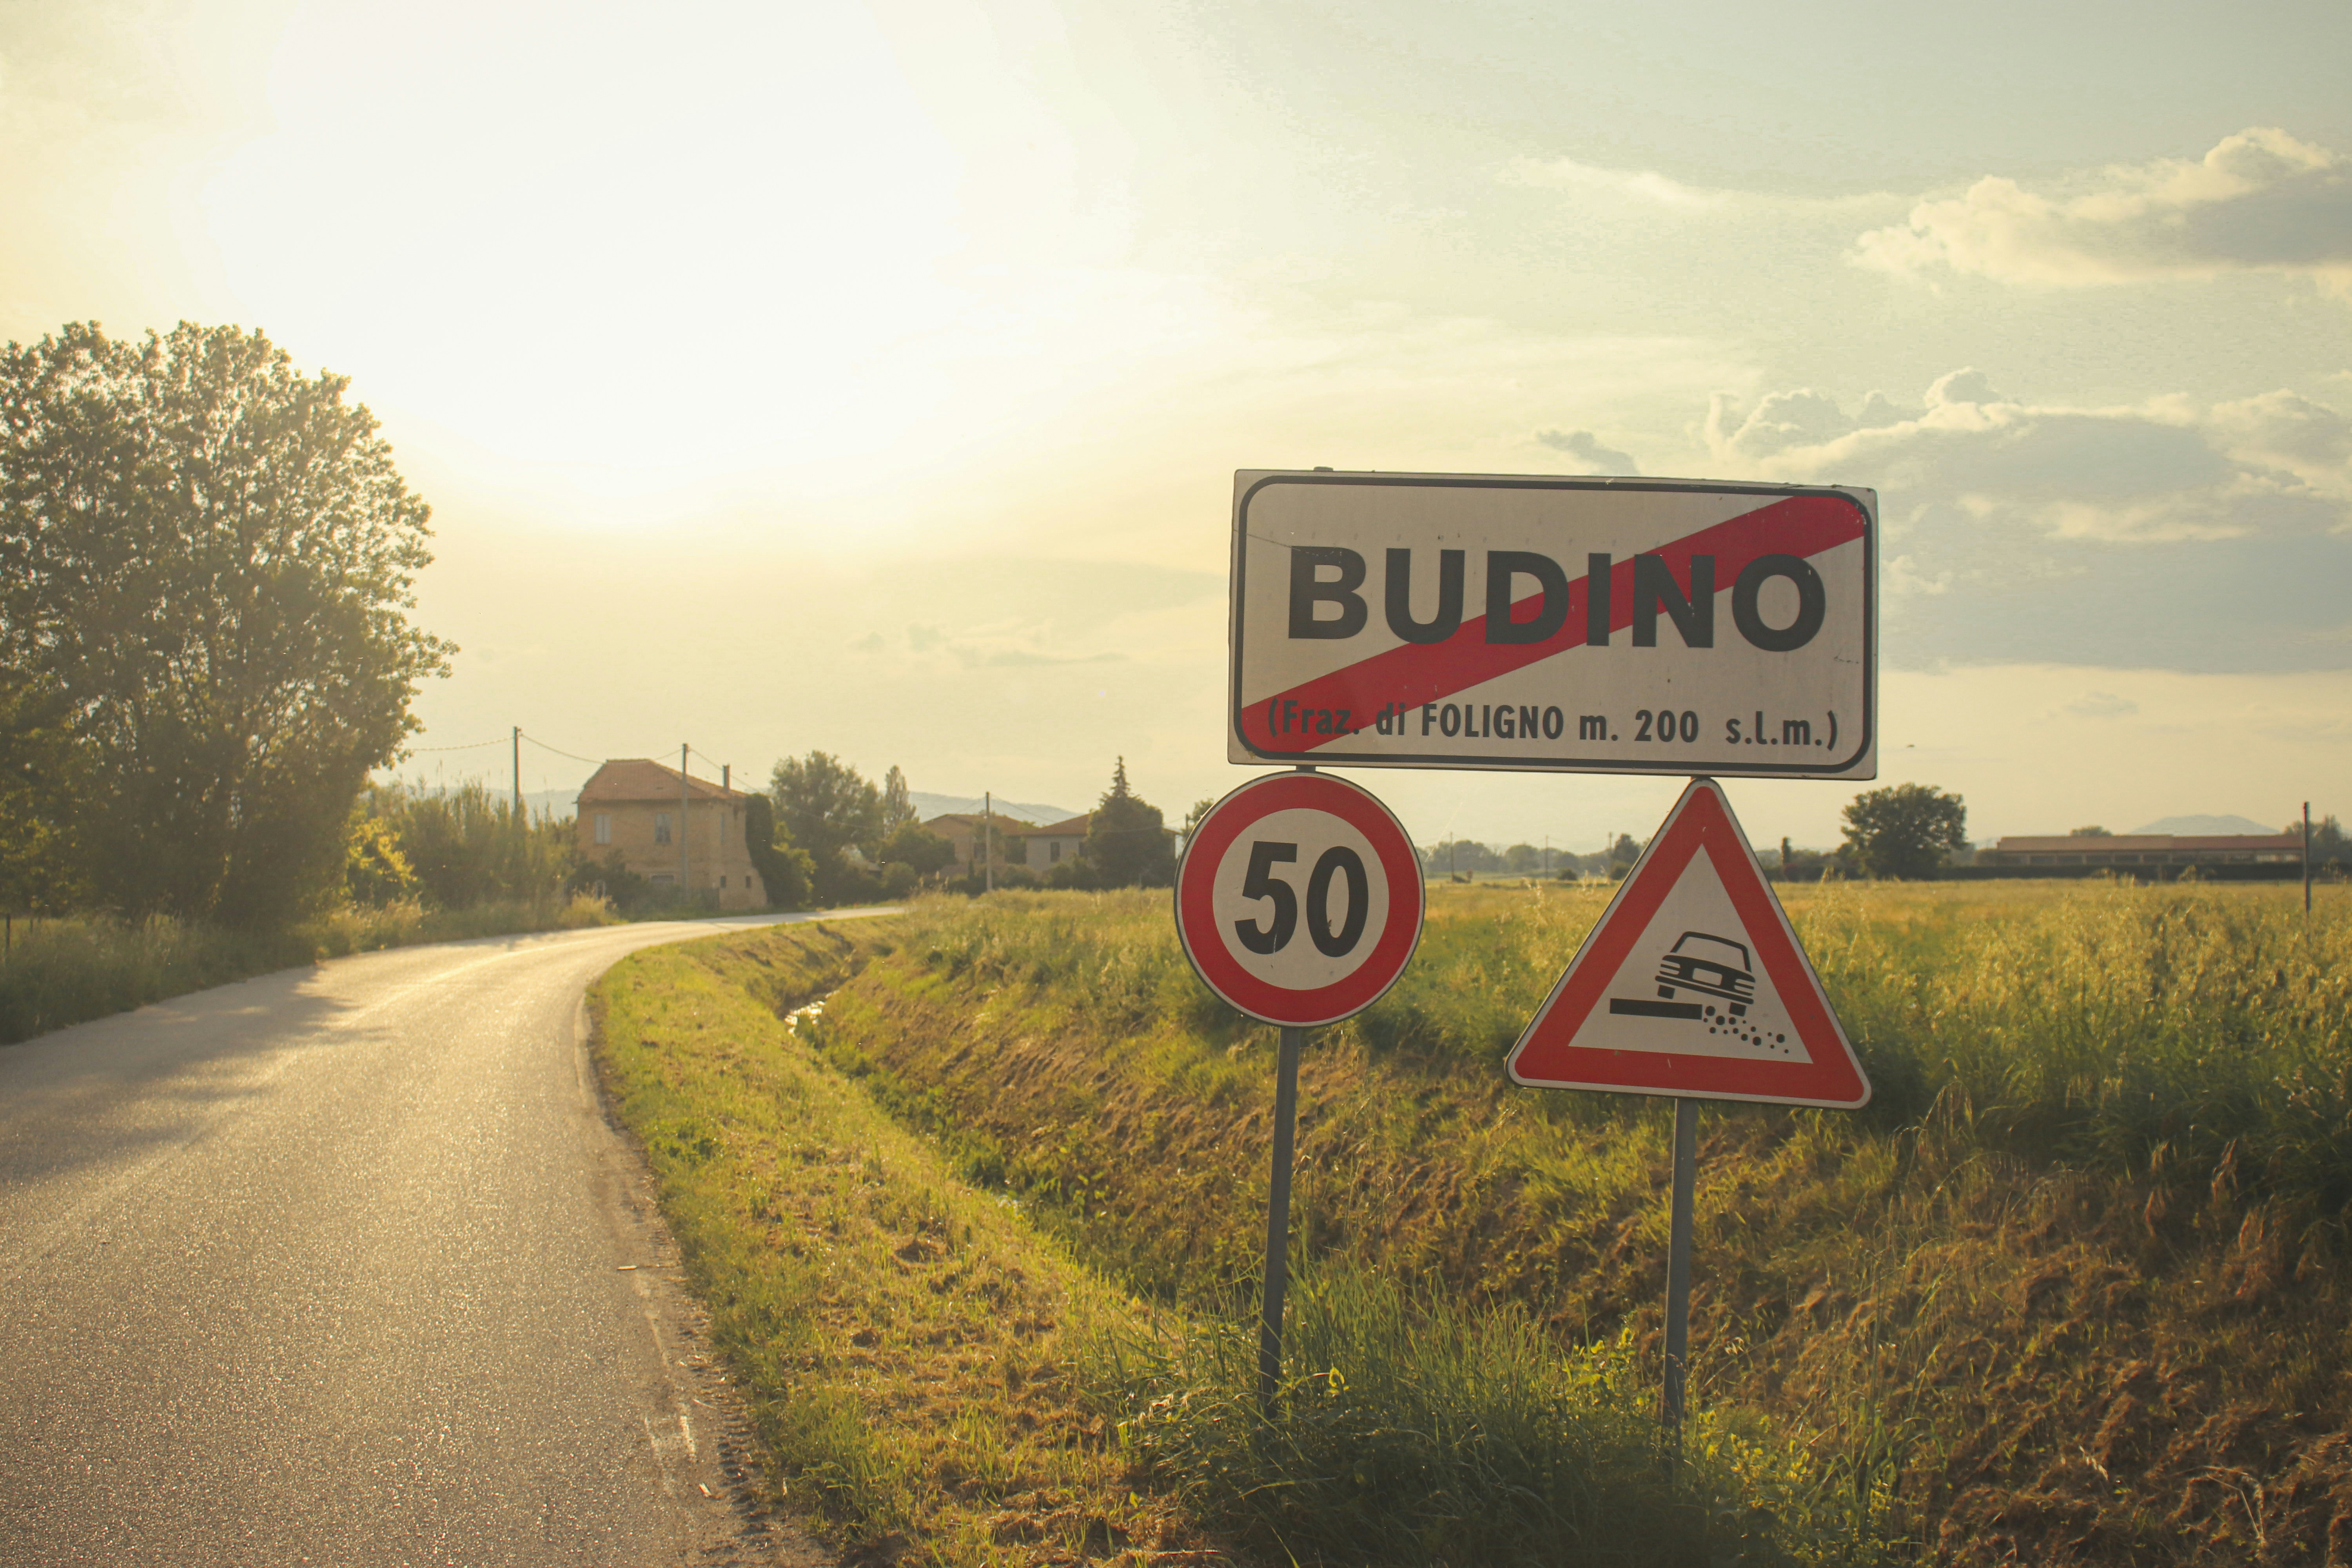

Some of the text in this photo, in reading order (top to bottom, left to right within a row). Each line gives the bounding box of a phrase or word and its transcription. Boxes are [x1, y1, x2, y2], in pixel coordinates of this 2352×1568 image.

[1288, 545, 1826, 652] BUDINO
[1269, 699, 1838, 751] (Fraz. di FOLIGNO m. 200 s.l.m.)
[1234, 840, 1369, 958] 50
